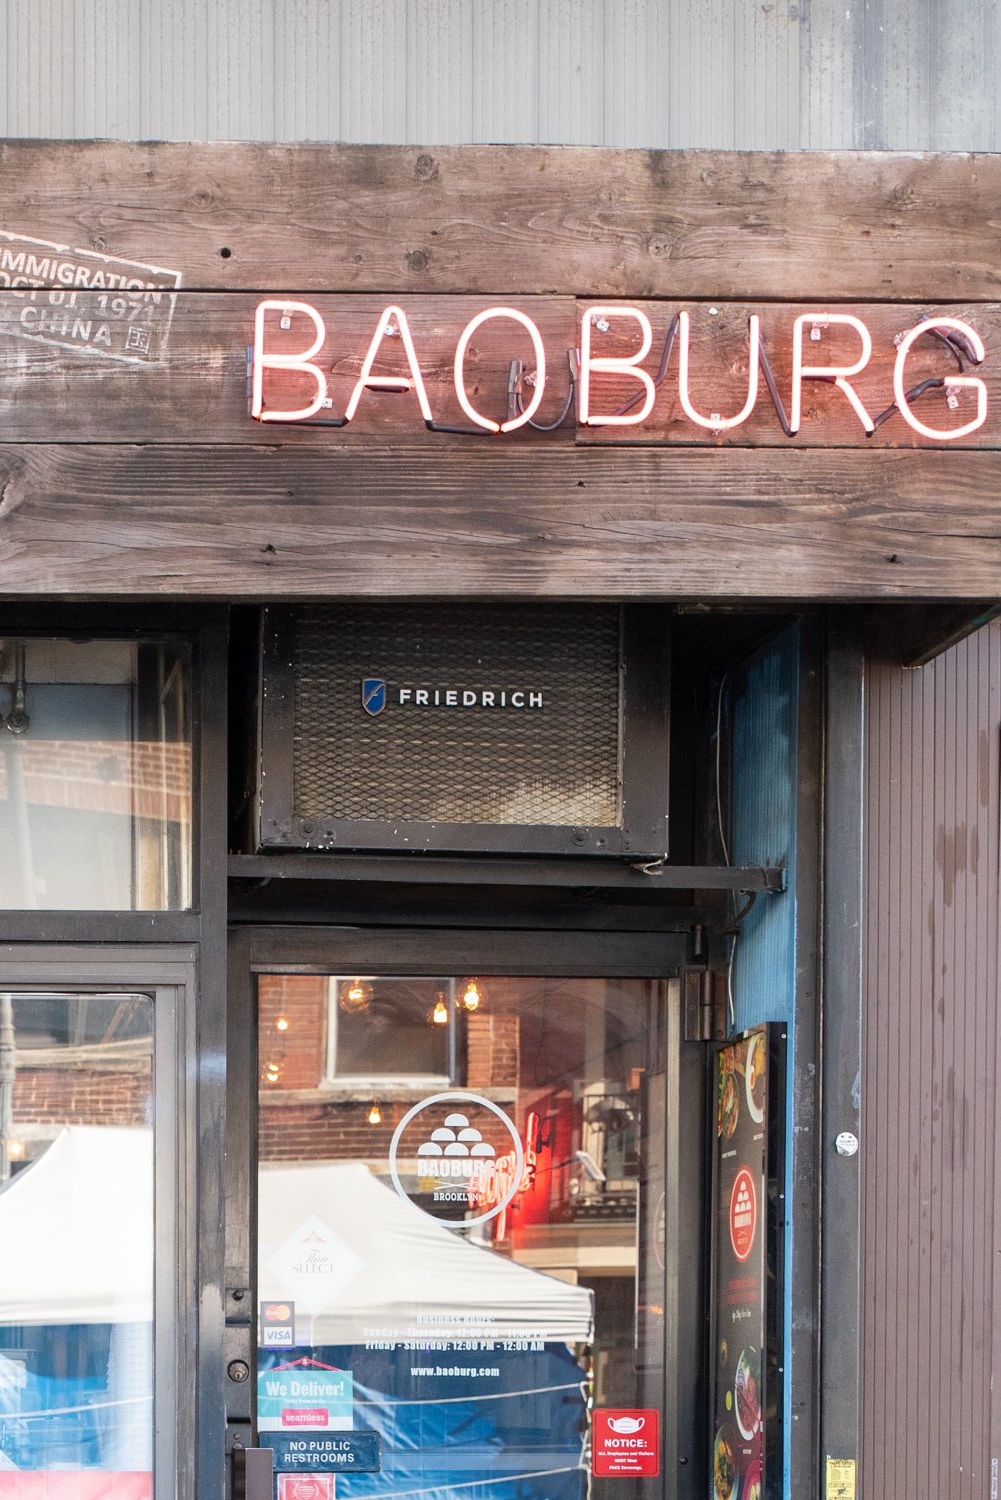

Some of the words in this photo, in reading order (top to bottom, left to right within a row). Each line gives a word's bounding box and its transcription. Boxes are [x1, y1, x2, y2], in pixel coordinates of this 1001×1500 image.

[20, 306, 112, 346] CHINA
[252, 299, 988, 441] BAOBURG
[399, 688, 544, 708] FRIEDRICH
[417, 1159, 496, 1177] BAOBURG
[433, 1192, 479, 1201] BROOKLYN
[305, 1248, 329, 1263] Thai
[292, 1263, 334, 1273] SELECT
[417, 1314, 461, 1325] Business
[266, 1330, 291, 1341] VISA
[363, 1327, 399, 1338] Sunday
[406, 1327, 455, 1338] Thursday:
[457, 1327, 482, 1337] 12:00
[365, 1340, 396, 1351] Friday
[404, 1340, 450, 1351] Saturday:
[453, 1340, 478, 1351] 12:00
[480, 1340, 495, 1351] PM
[503, 1340, 528, 1351] 12:00
[530, 1340, 545, 1351] AM
[410, 1366, 500, 1377] www.baoburg.com
[266, 1381, 288, 1396] We
[290, 1381, 344, 1396] Deliver!
[285, 1413, 325, 1422] seamless
[290, 1441, 307, 1451] NO
[309, 1441, 350, 1451] PUBLIC
[604, 1439, 648, 1448] NOTICE:
[284, 1453, 355, 1463] RESTROOMS
